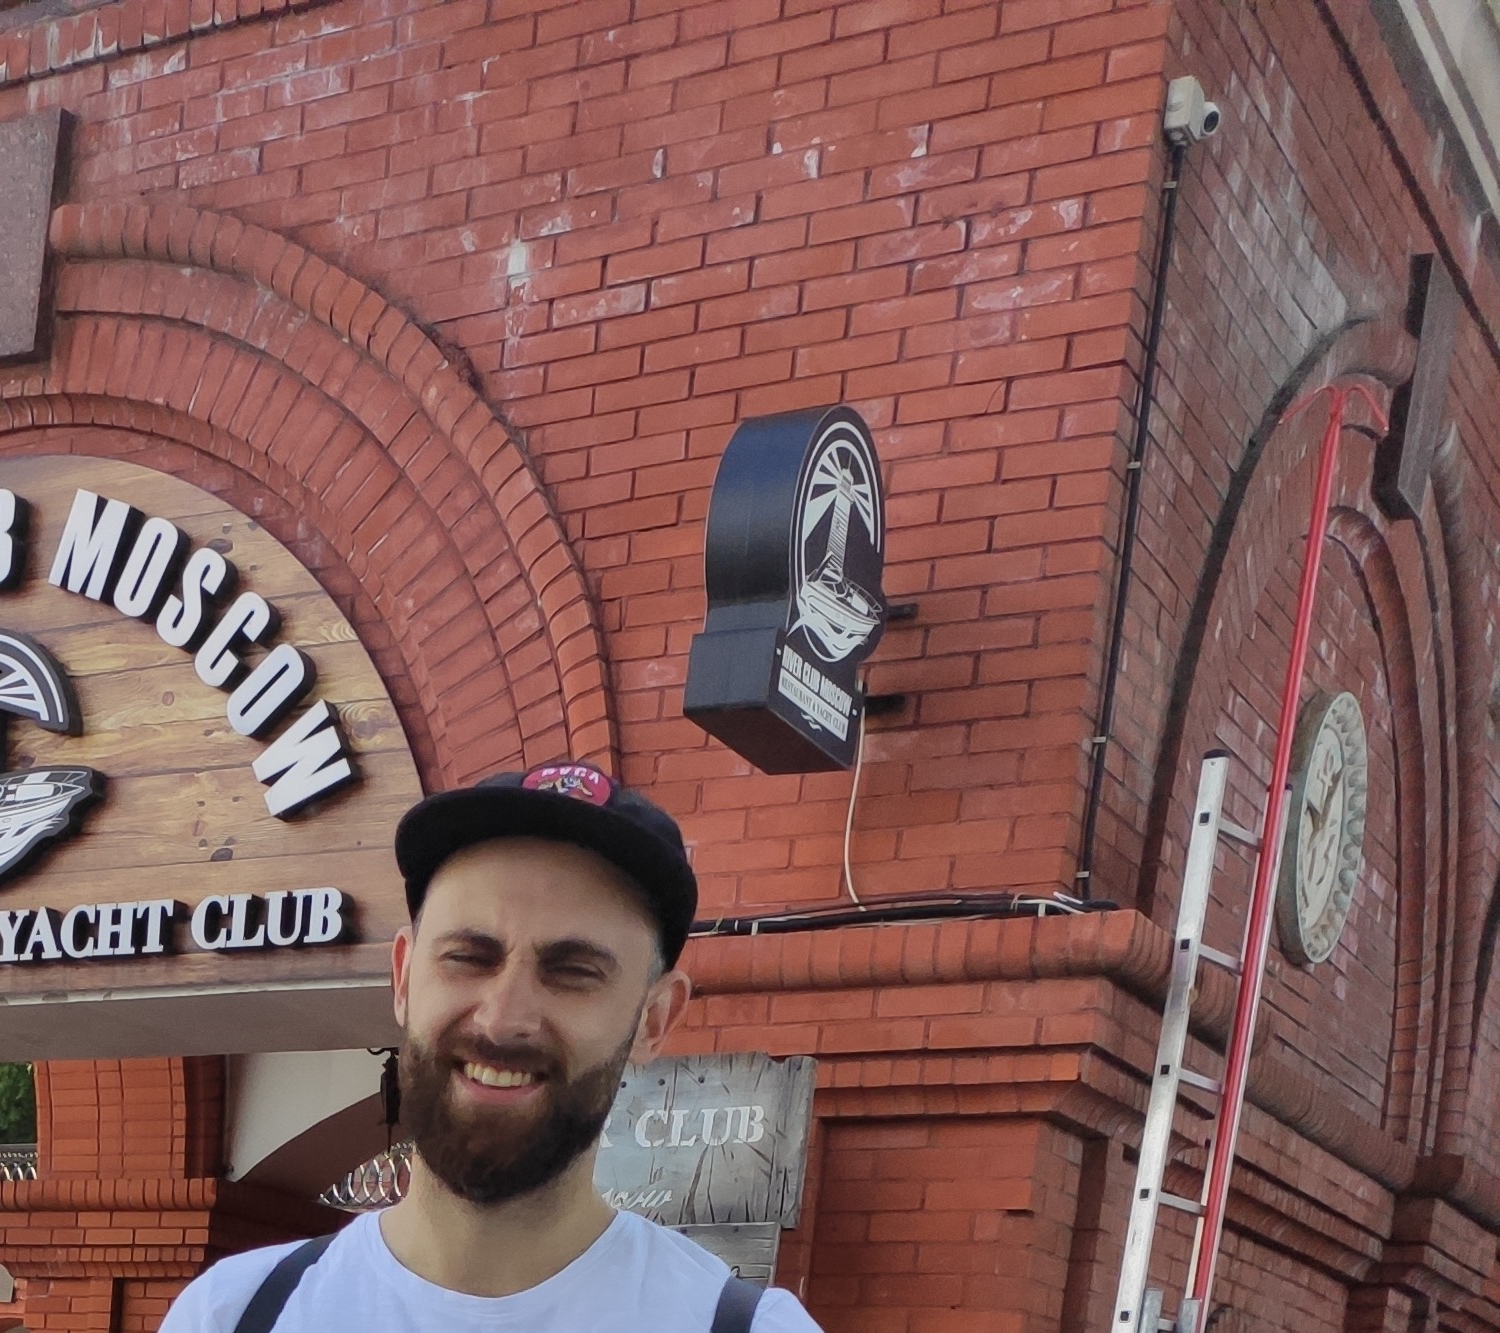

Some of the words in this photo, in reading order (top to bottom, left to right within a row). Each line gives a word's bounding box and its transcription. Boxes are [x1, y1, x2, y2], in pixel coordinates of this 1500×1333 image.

[48, 488, 352, 817] MOSCOW
[781, 644, 804, 680] RIVER
[802, 661, 821, 693] CLUB
[819, 674, 853, 717] MOSCOW
[190, 886, 344, 951] CLUB
[635, 1105, 765, 1149] CLUB
